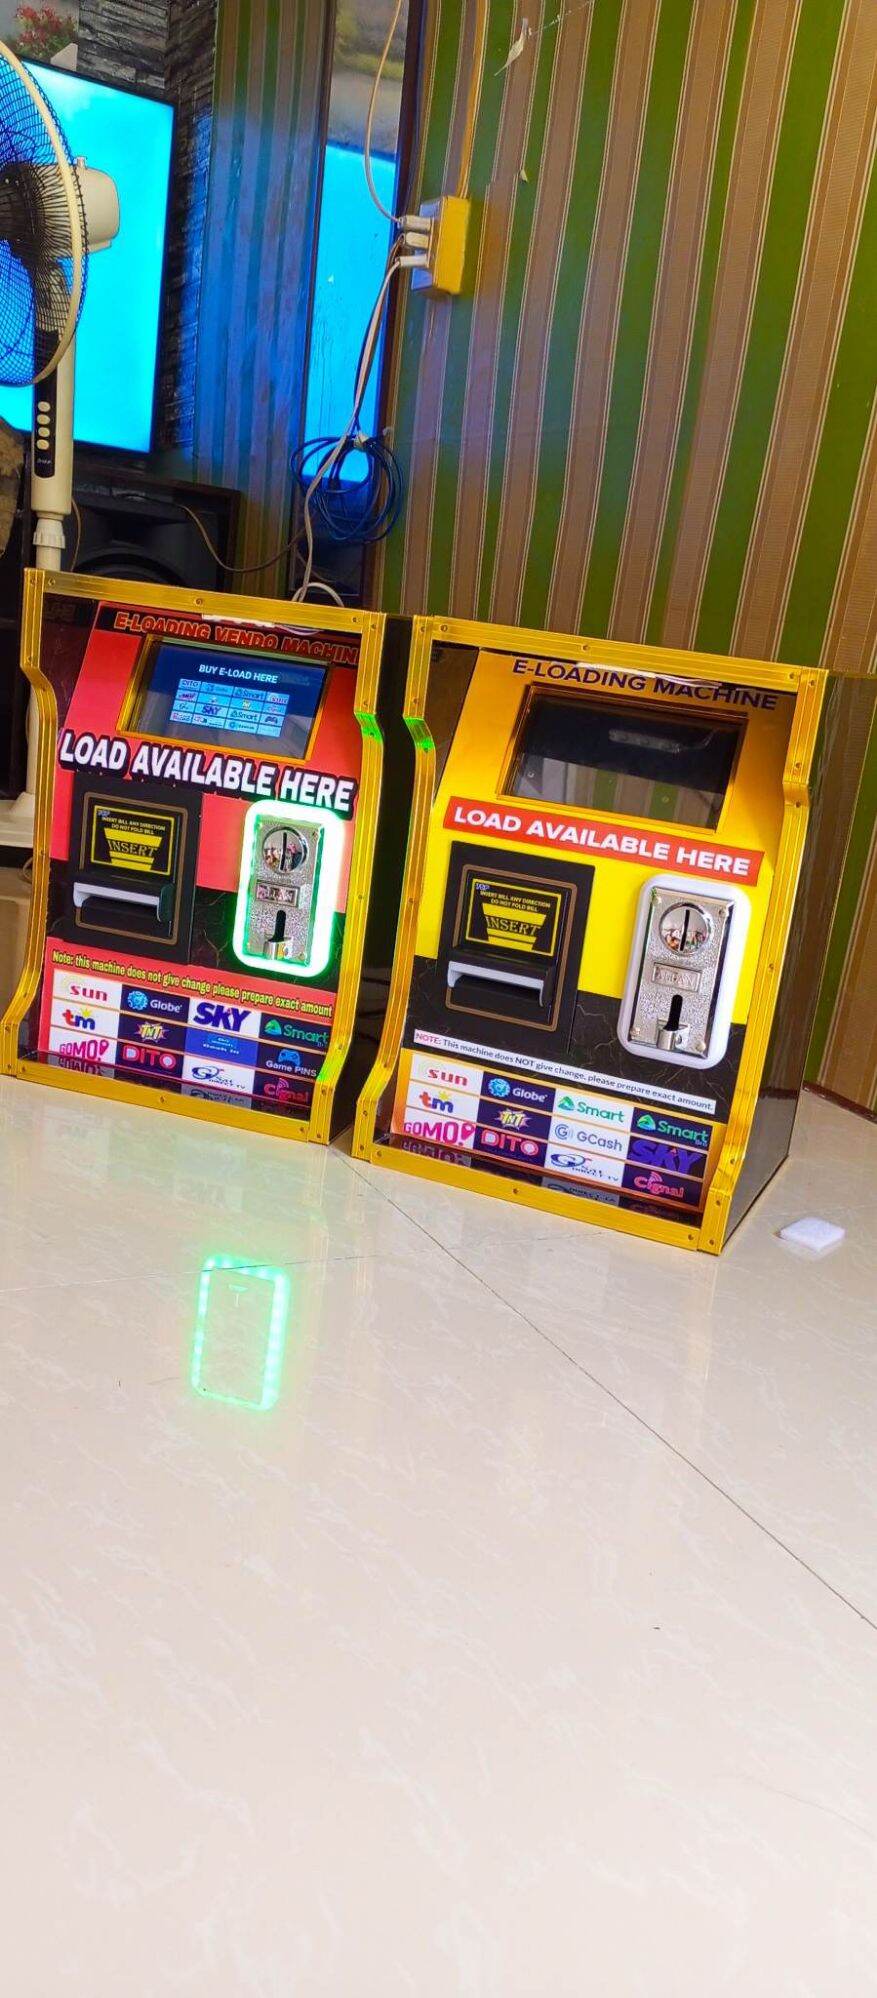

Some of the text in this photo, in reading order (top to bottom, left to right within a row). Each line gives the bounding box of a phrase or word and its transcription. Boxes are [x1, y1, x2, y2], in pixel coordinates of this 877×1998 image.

[114, 612, 360, 665] E-LOADING VENDO MACHIN
[199, 664, 279, 684] BUY E-LOAD HERE
[512, 659, 777, 711] E-LOADING MACHINE
[59, 732, 354, 812] LOAD AVAILABLE HERE
[108, 840, 157, 857] INSERT
[453, 806, 751, 876] LOAD AVAILABLE HERE
[512, 902, 526, 910] FOLD
[522, 898, 551, 908] DIRECTION
[485, 916, 541, 936] INSERT
[52, 949, 333, 1018] Note: this machine does not give change please prepare exact amount
[69, 985, 108, 1001] sun
[150, 998, 181, 1013] Globe
[62, 1009, 95, 1030] tm
[193, 1002, 252, 1032] SKY
[283, 1024, 329, 1043] Smart
[122, 1044, 177, 1069] DITO
[266, 1060, 317, 1077] Game PINS
[415, 1032, 441, 1045] NOTE:
[442, 1038, 459, 1049] This
[460, 1043, 494, 1058] machine
[495, 1051, 514, 1063] does
[515, 1056, 534, 1068] NOT
[536, 1061, 553, 1072] give
[588, 1074, 615, 1087] please
[616, 1082, 651, 1097] prepare
[652, 1089, 676, 1102] exact
[677, 1096, 713, 1111] amount.
[427, 1068, 468, 1087] sun
[418, 1091, 454, 1114] tm
[512, 1086, 547, 1103] Globe
[577, 1101, 625, 1123] Smart
[577, 1131, 623, 1152] GCash
[657, 1120, 709, 1142] Smart
[481, 1129, 539, 1156] DITO
[628, 1139, 701, 1175] SKY
